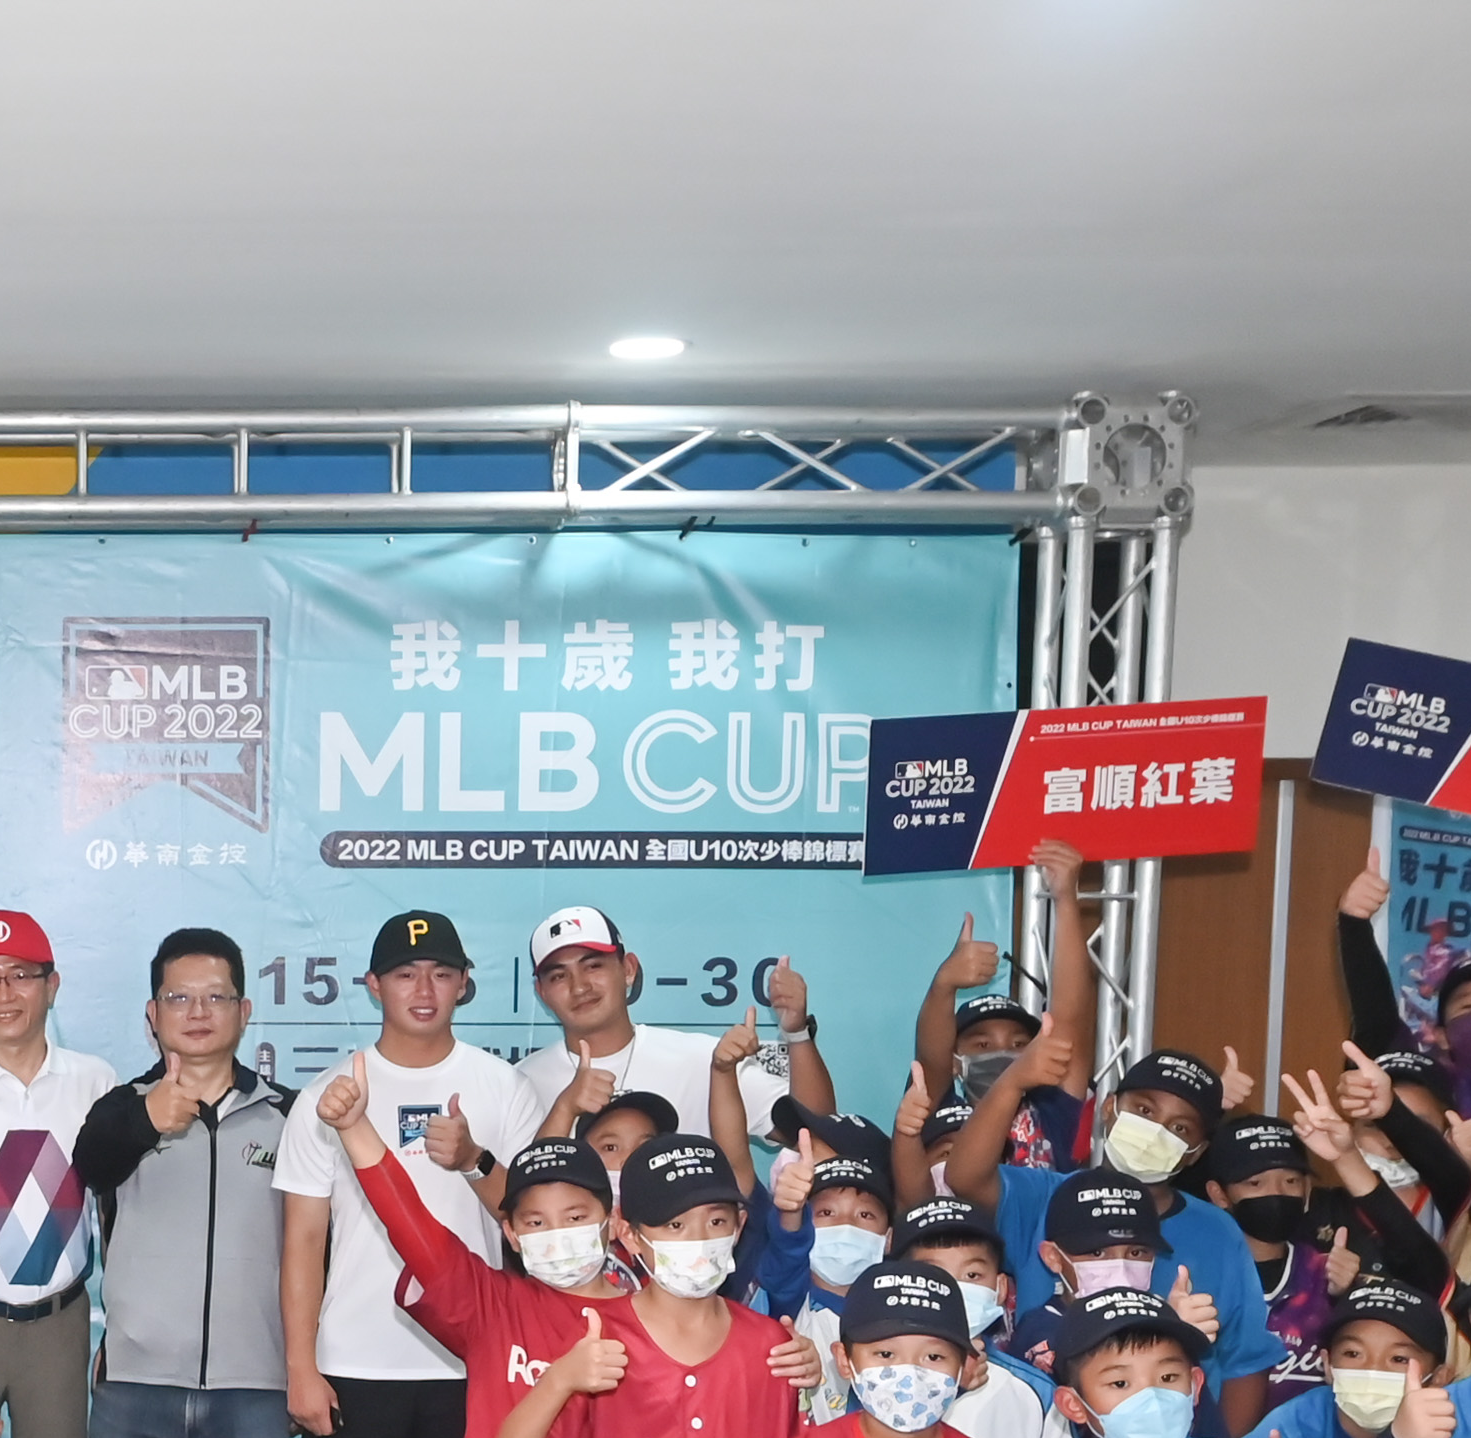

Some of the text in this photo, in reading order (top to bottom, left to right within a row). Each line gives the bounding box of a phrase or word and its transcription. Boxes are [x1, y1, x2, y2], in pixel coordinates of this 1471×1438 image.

[389, 618, 825, 692] 我十歲 我打
[151, 665, 248, 700] MLB
[68, 704, 263, 739] CUP 2022
[319, 709, 872, 814] MLB CUP
[925, 758, 968, 777] MLB
[885, 775, 975, 798] CUP 2022
[1043, 757, 1236, 815] 富順紅葉
[910, 798, 949, 809] TAIWAN
[123, 842, 247, 866] 華南金控
[338, 839, 401, 862] 2022
[407, 839, 464, 861] MLB
[469, 839, 526, 861] CUP
[532, 838, 638, 861] TAIWAN
